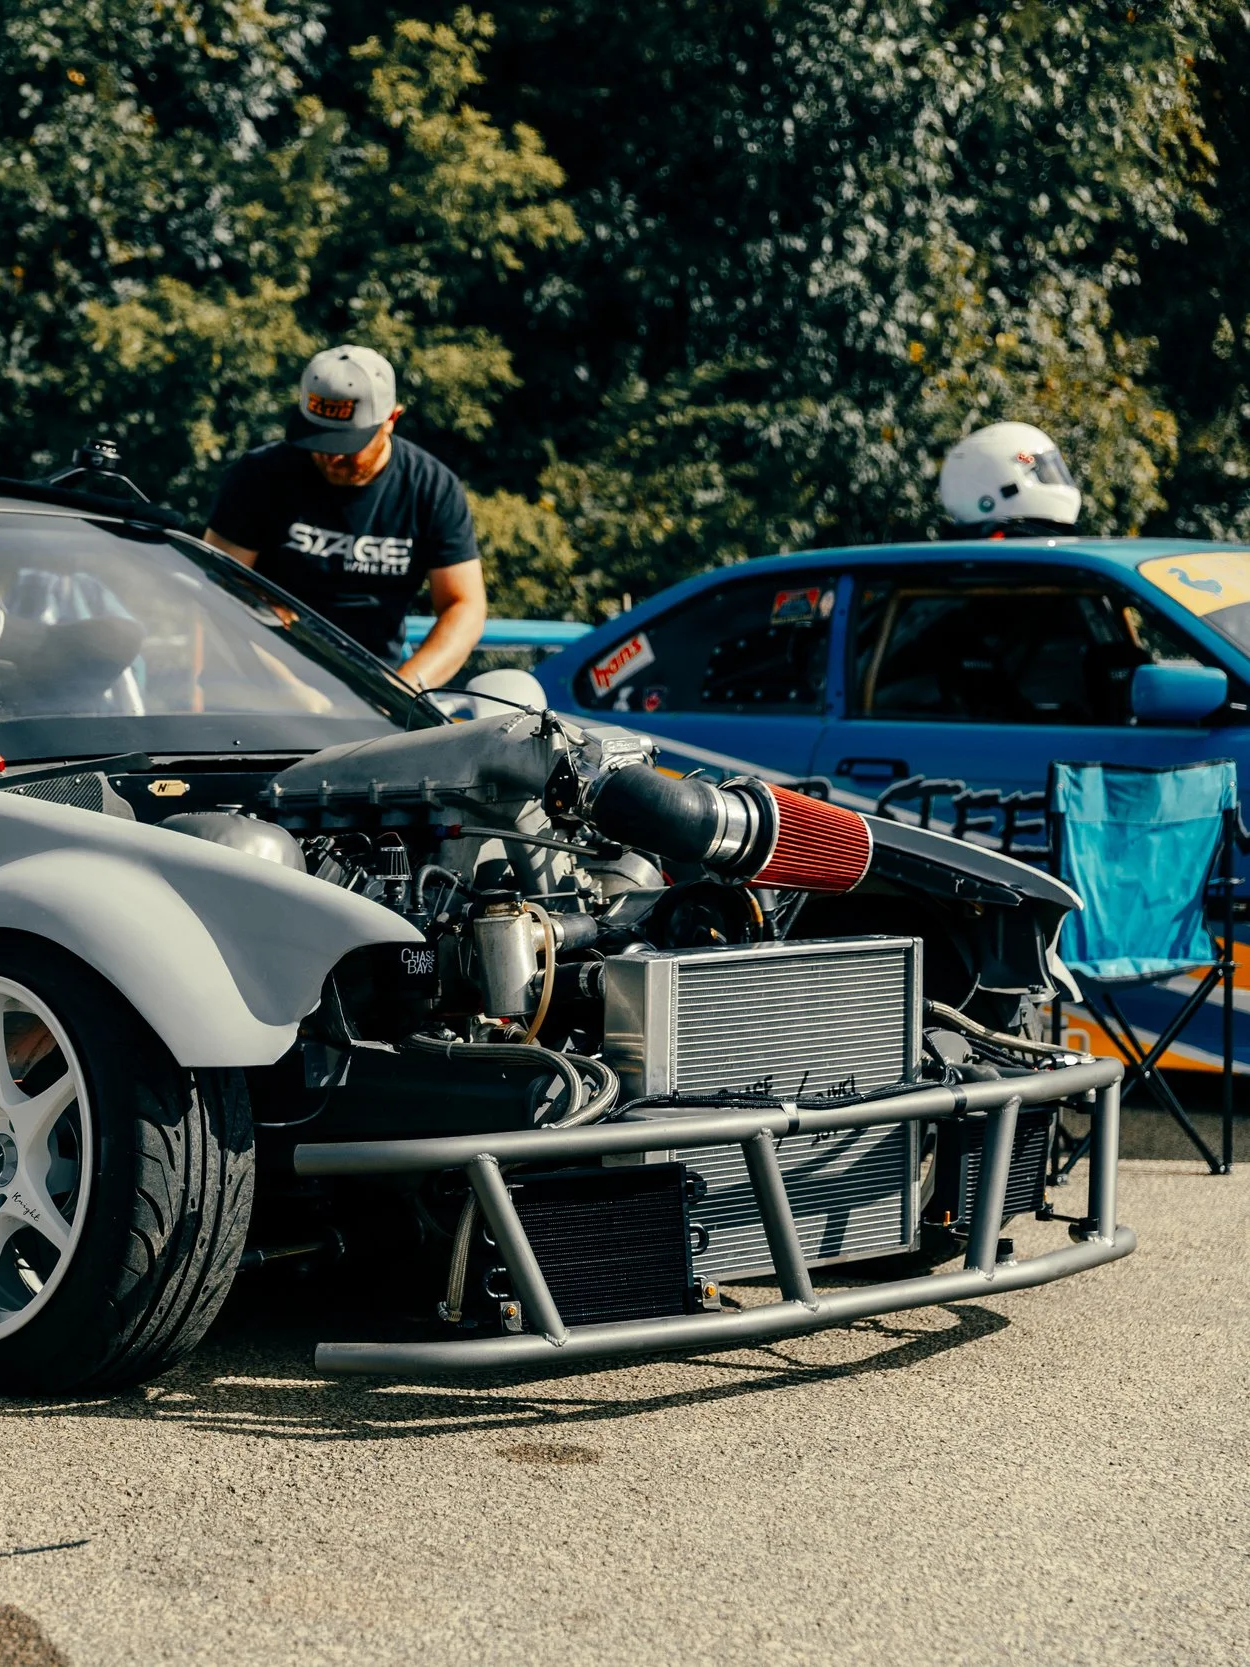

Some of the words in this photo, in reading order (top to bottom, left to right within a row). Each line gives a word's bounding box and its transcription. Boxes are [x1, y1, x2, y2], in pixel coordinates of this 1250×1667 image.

[284, 522, 413, 564] STAGE
[343, 560, 409, 575] WHEELS
[401, 947, 436, 963] CHASE
[407, 959, 434, 975] BAYS
[11, 1191, 41, 1222] Knight
